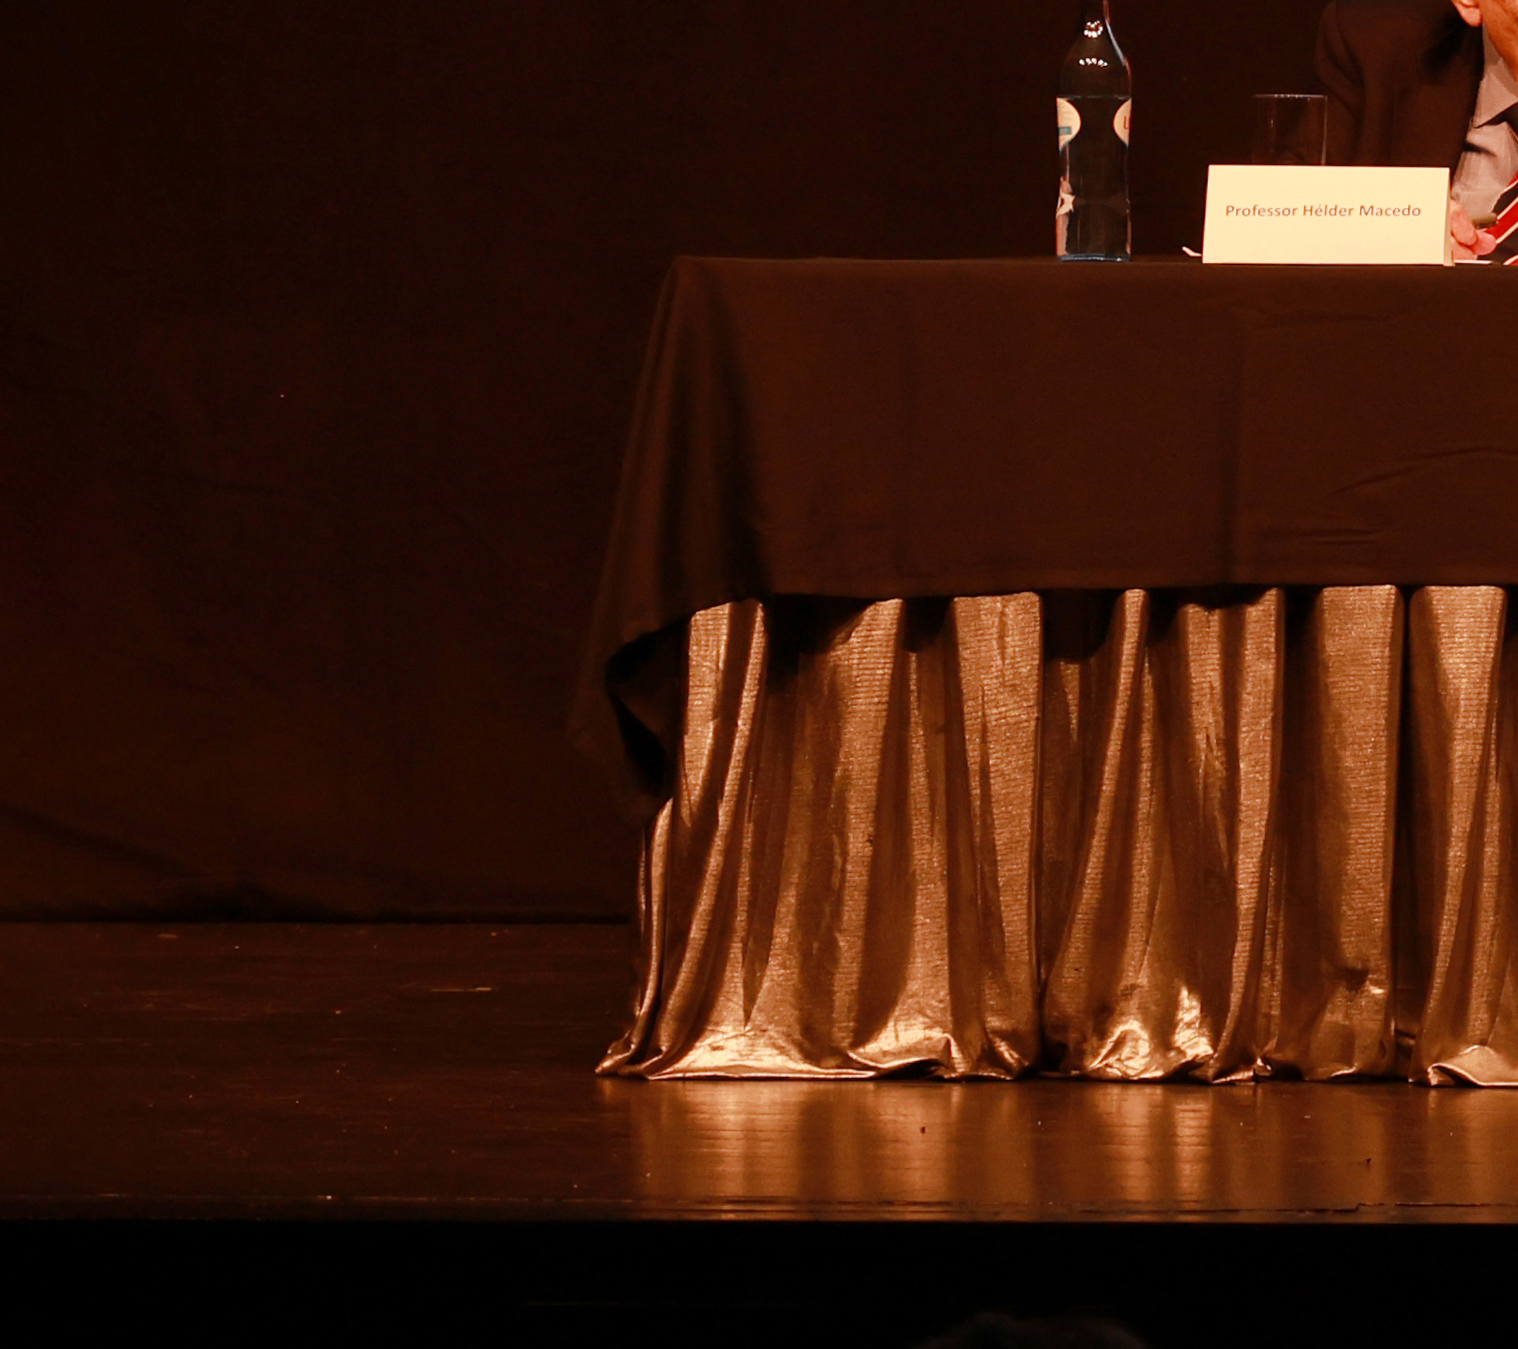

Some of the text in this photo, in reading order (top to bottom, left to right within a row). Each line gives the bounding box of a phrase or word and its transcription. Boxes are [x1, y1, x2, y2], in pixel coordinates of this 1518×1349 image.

[1225, 204, 1421, 218] Professor Hélder Macedo
